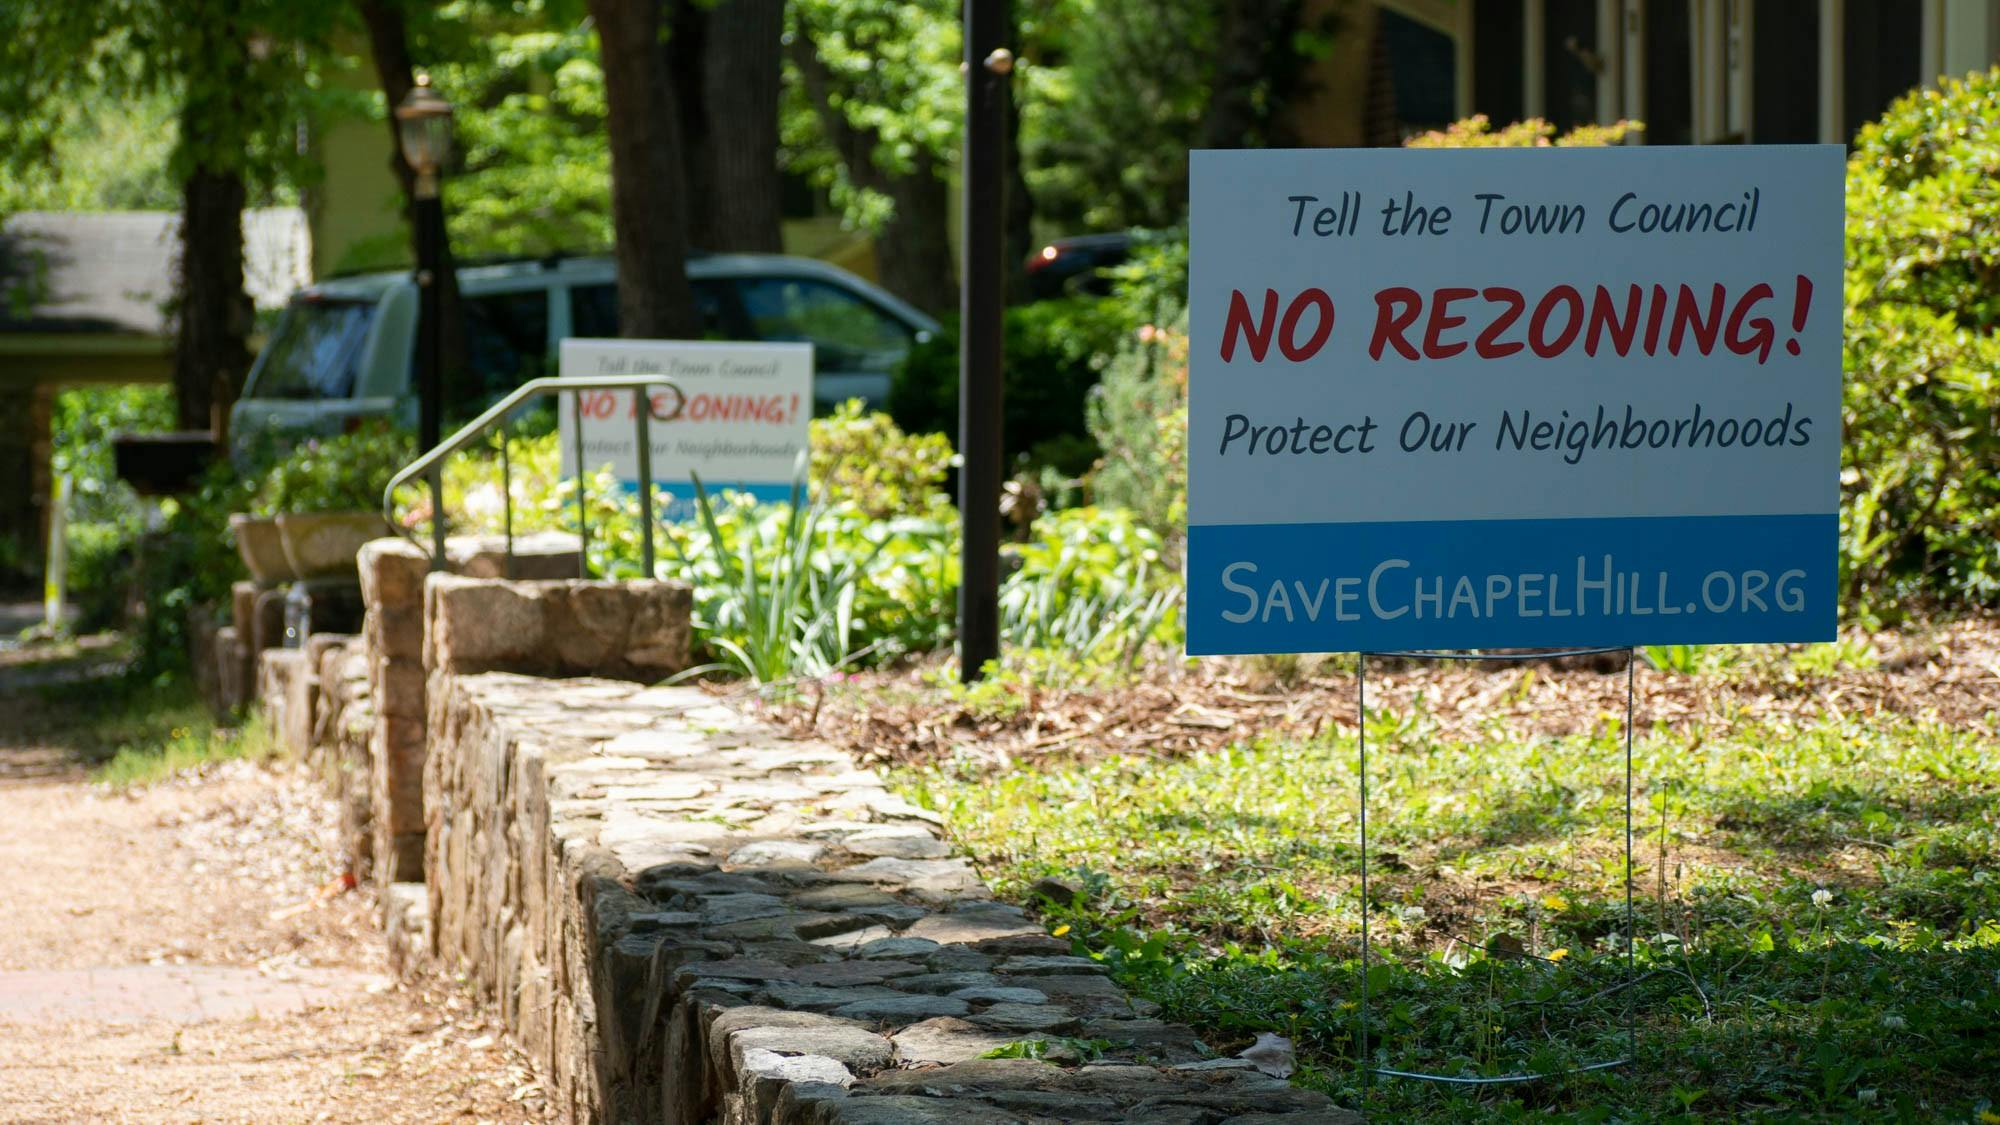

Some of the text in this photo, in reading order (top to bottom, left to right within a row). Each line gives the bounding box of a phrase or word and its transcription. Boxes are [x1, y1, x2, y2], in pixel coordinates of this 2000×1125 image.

[1288, 187, 1761, 239] Tell the Town Council
[1220, 274, 1814, 365] NO REZONING!
[1220, 403, 1813, 465] Protect Our Neighborhoods
